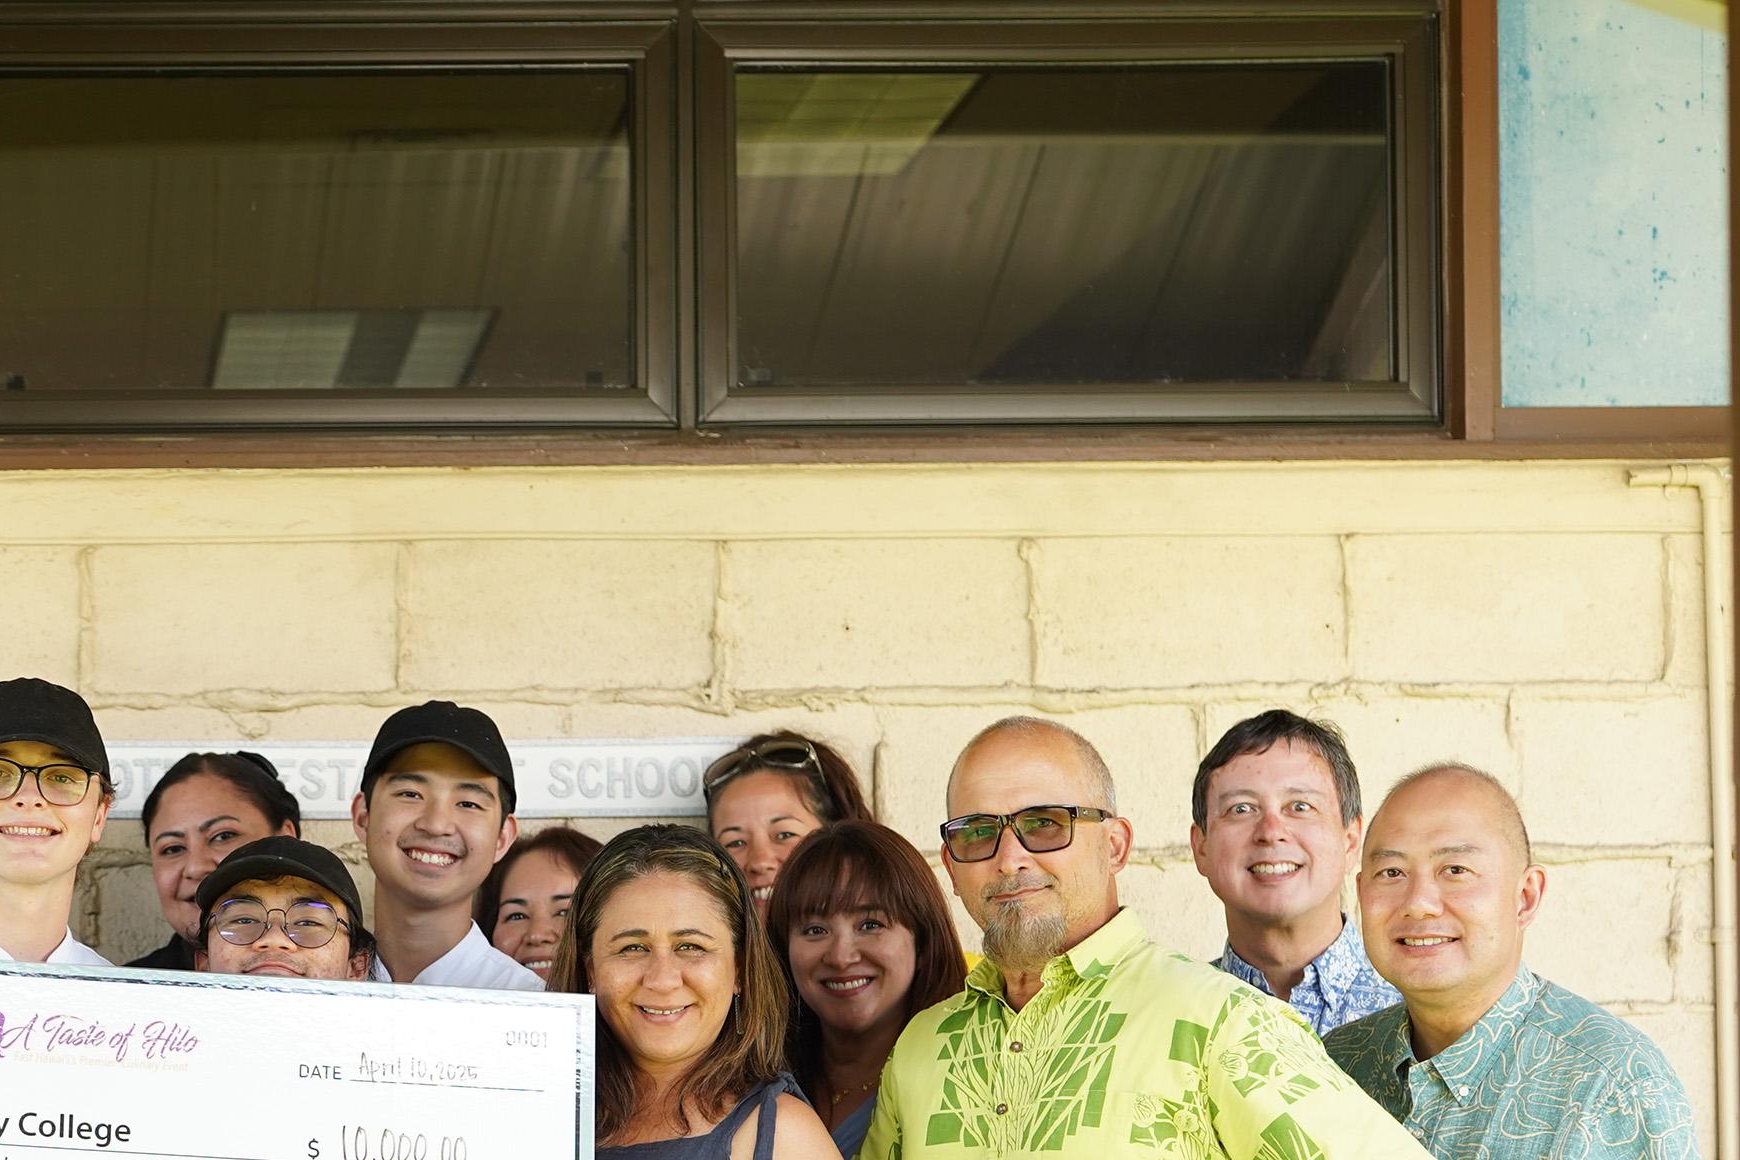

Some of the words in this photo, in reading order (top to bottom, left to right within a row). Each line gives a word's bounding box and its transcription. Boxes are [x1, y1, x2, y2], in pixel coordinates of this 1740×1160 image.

[548, 756, 709, 799] SCHOO
[0, 1013, 39, 1050] A
[42, 1014, 107, 1052] Taste
[109, 1023, 136, 1062] of
[142, 1020, 201, 1060] Hilo
[299, 1064, 342, 1080] DATE
[19, 1112, 132, 1148] College
[307, 1138, 320, 1160] $
